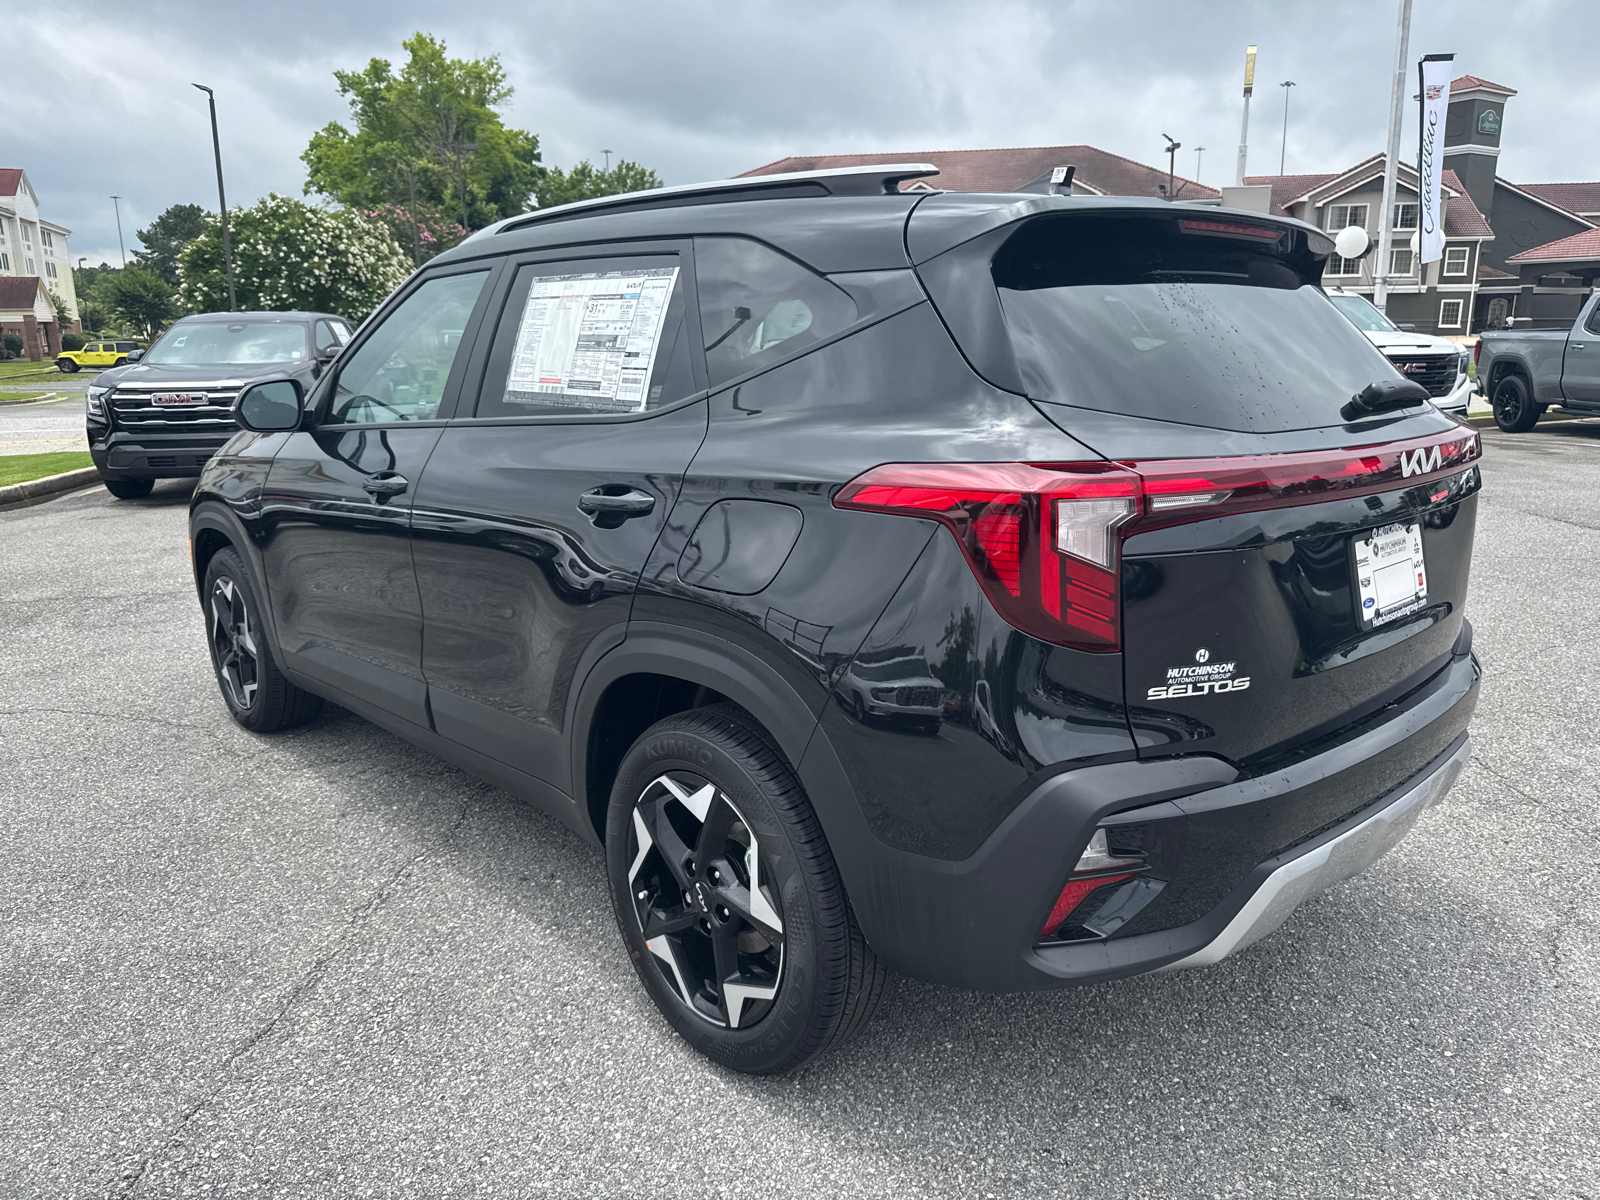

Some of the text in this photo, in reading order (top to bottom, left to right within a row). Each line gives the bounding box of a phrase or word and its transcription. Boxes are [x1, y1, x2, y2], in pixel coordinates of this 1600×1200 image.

[1423, 110, 1437, 234] Cadillac
[589, 304, 598, 313] 31
[1394, 363, 1427, 372] MC
[153, 393, 205, 404] GMC
[1400, 445, 1442, 478] KIA
[1167, 663, 1235, 678] HUTCHINSON
[1168, 673, 1232, 685] AUTOMOTIVE GROUP
[1147, 677, 1251, 701] SELTOS
[646, 739, 712, 765] KUMHO
